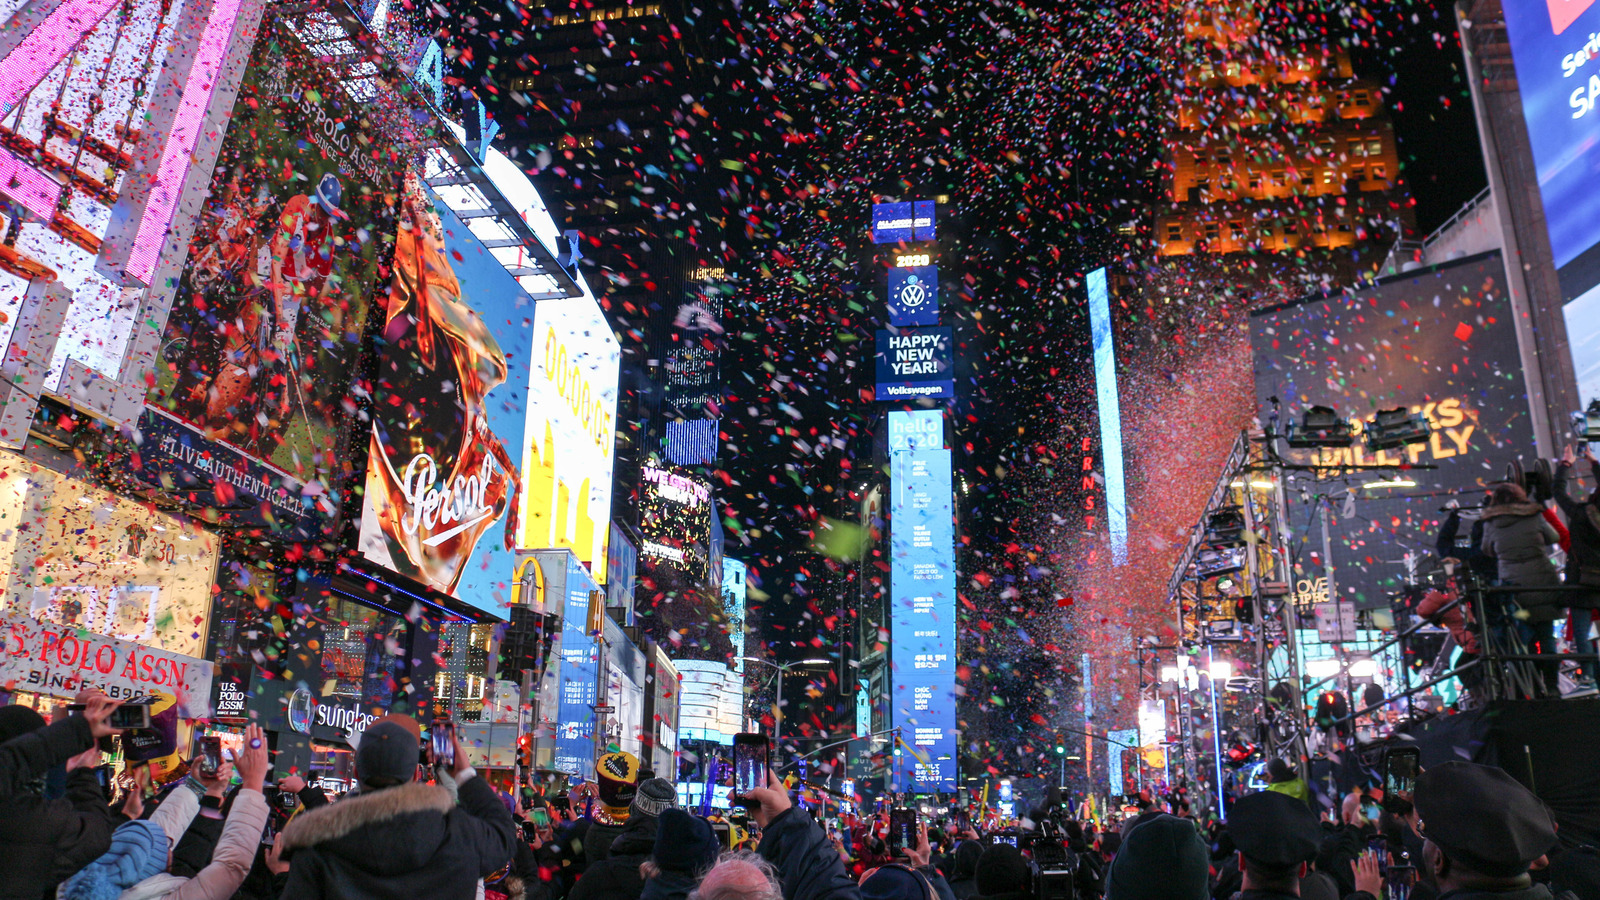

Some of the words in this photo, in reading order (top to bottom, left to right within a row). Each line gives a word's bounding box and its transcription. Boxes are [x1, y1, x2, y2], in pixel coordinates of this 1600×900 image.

[1569, 68, 1600, 119] SA
[314, 107, 350, 152] POLO
[315, 132, 338, 162] SINCE
[338, 157, 355, 179] 1890
[896, 254, 930, 267] 2020
[889, 334, 941, 349] HAPPY
[891, 361, 938, 375] YEAR!
[896, 348, 934, 362] NEW
[545, 326, 610, 458] 00:00:05
[887, 385, 942, 396] Volkswagen
[893, 418, 938, 433] hello
[893, 434, 939, 448] 2020
[1311, 446, 1400, 479] WILL
[1407, 425, 1475, 463] FLY
[159, 435, 308, 517] #LIVEAUTHENTICALLY
[643, 466, 669, 484] WE
[669, 474, 692, 496] GET
[692, 481, 709, 504] YOU
[1081, 437, 1096, 531] ERNST
[401, 453, 493, 547] Persol
[1296, 577, 1329, 594] OVE
[38, 630, 116, 674] POLO
[120, 650, 190, 690] ASSN.
[219, 692, 244, 701] POLO
[221, 682, 237, 692] U.S.
[217, 700, 244, 710] ASSN.
[317, 703, 380, 738] sunglas
